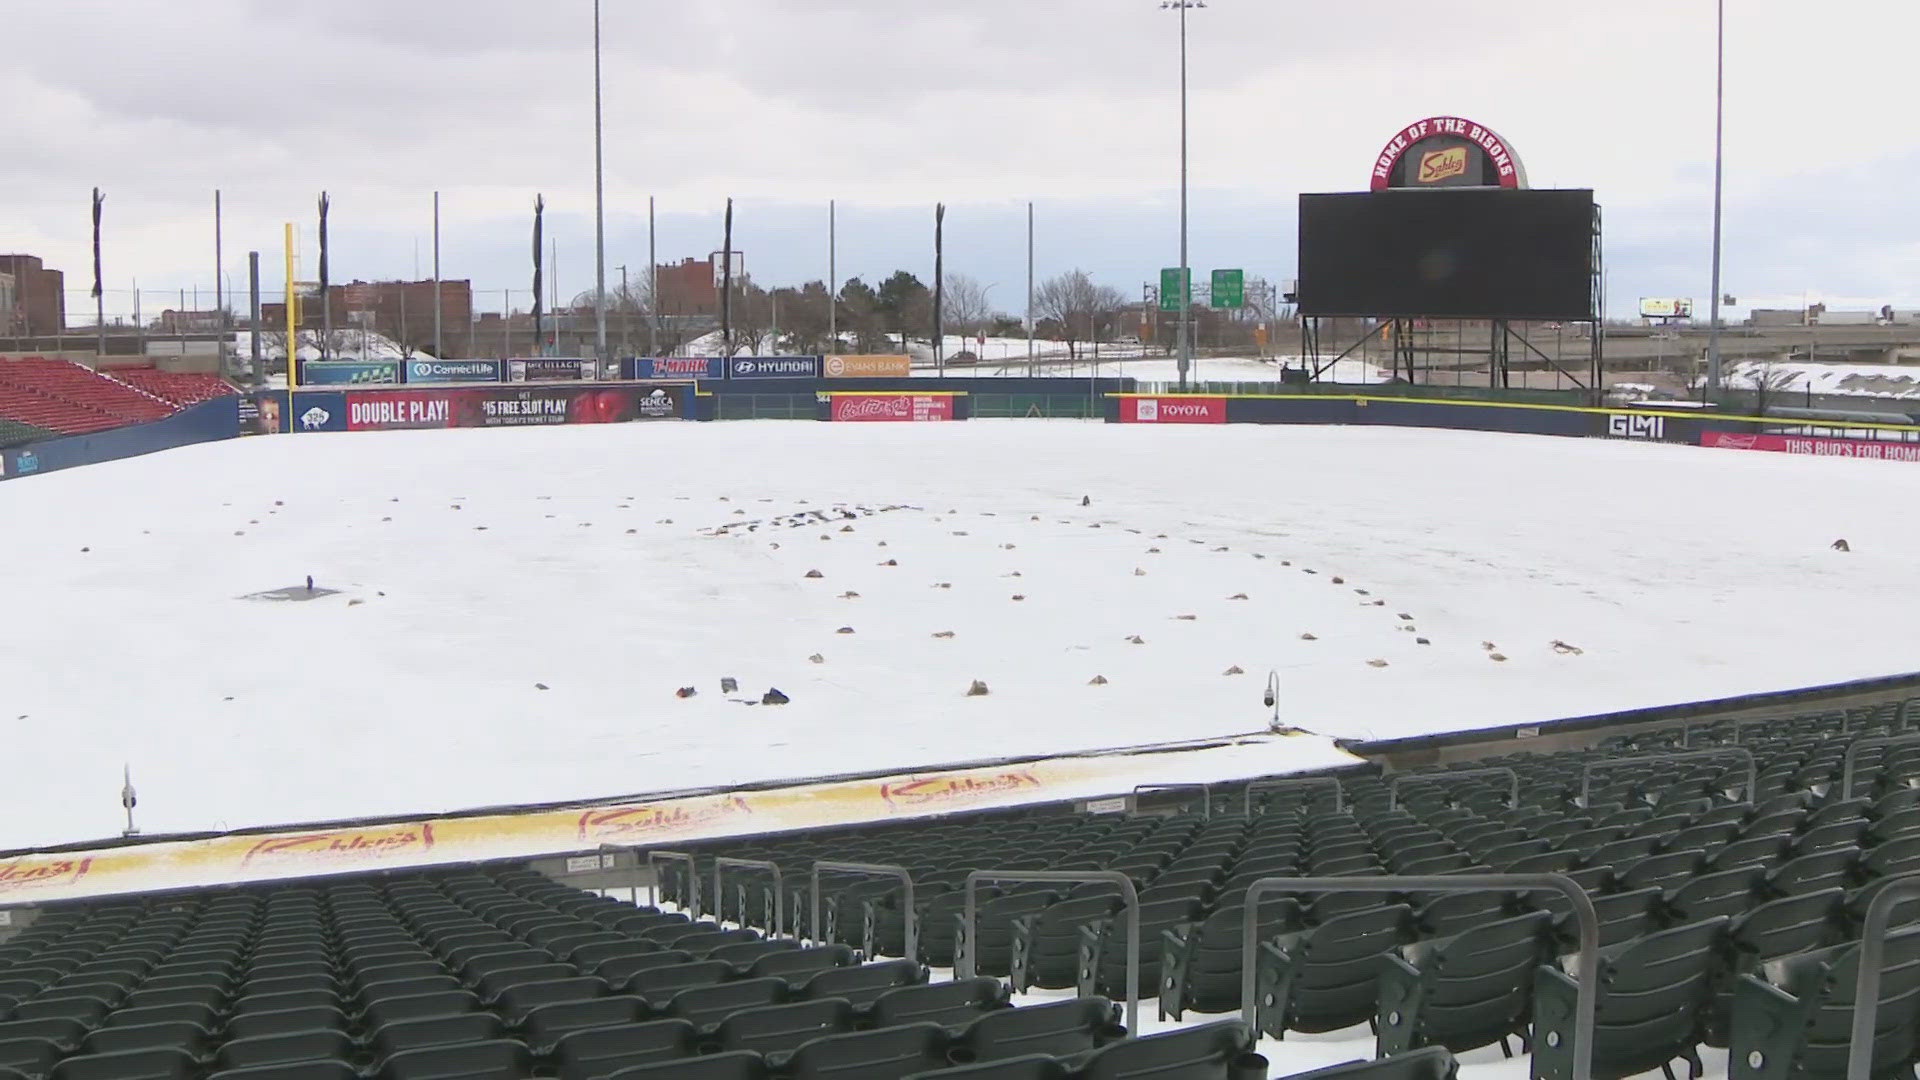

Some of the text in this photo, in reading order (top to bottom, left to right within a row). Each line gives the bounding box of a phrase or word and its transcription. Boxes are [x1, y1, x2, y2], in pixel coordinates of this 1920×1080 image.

[1374, 119, 1513, 178] HOME OF THE BISONS
[758, 361, 813, 372] HYUNDAI
[846, 362, 906, 372] EVANS BANK
[482, 399, 567, 416] $15 FREE SLOT PLAY
[640, 397, 673, 406] SENECA
[351, 400, 449, 424] DOUBLE PLAY!
[1161, 404, 1208, 417] TOYOTA
[1609, 414, 1664, 439] GLMI
[1785, 439, 1813, 455] THIS
[1815, 442, 1853, 458] BUD'S
[1856, 445, 1881, 459] FOR
